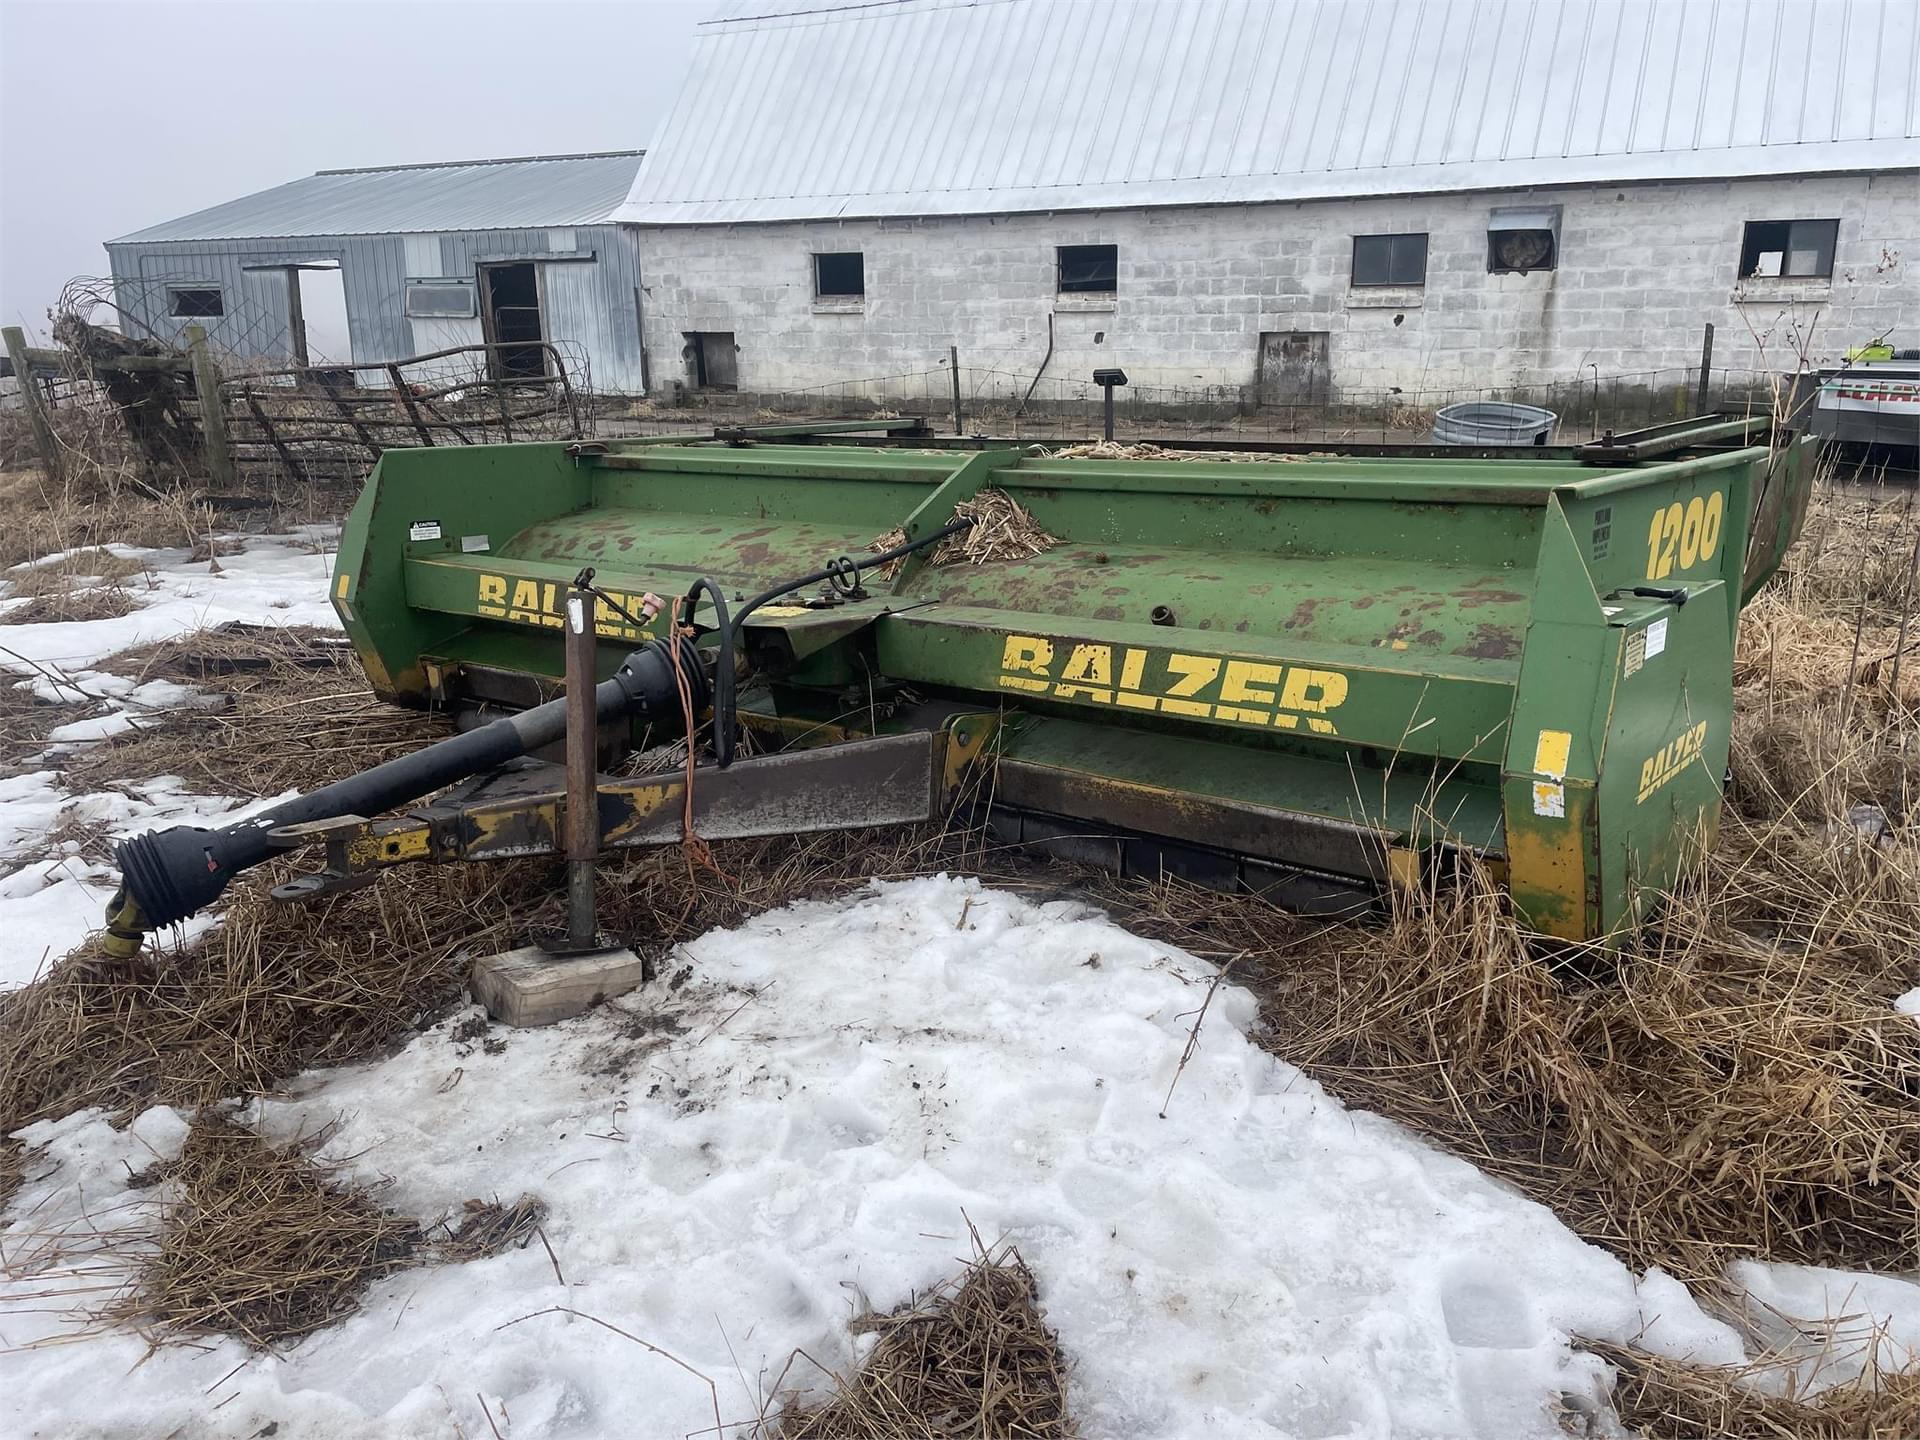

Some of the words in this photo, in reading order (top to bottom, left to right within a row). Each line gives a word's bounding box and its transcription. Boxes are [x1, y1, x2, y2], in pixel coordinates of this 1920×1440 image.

[1646, 491, 1723, 580] 1200
[478, 574, 657, 641] BALER
[999, 634, 1349, 735] BALZER
[1636, 720, 1707, 806] BALZER
